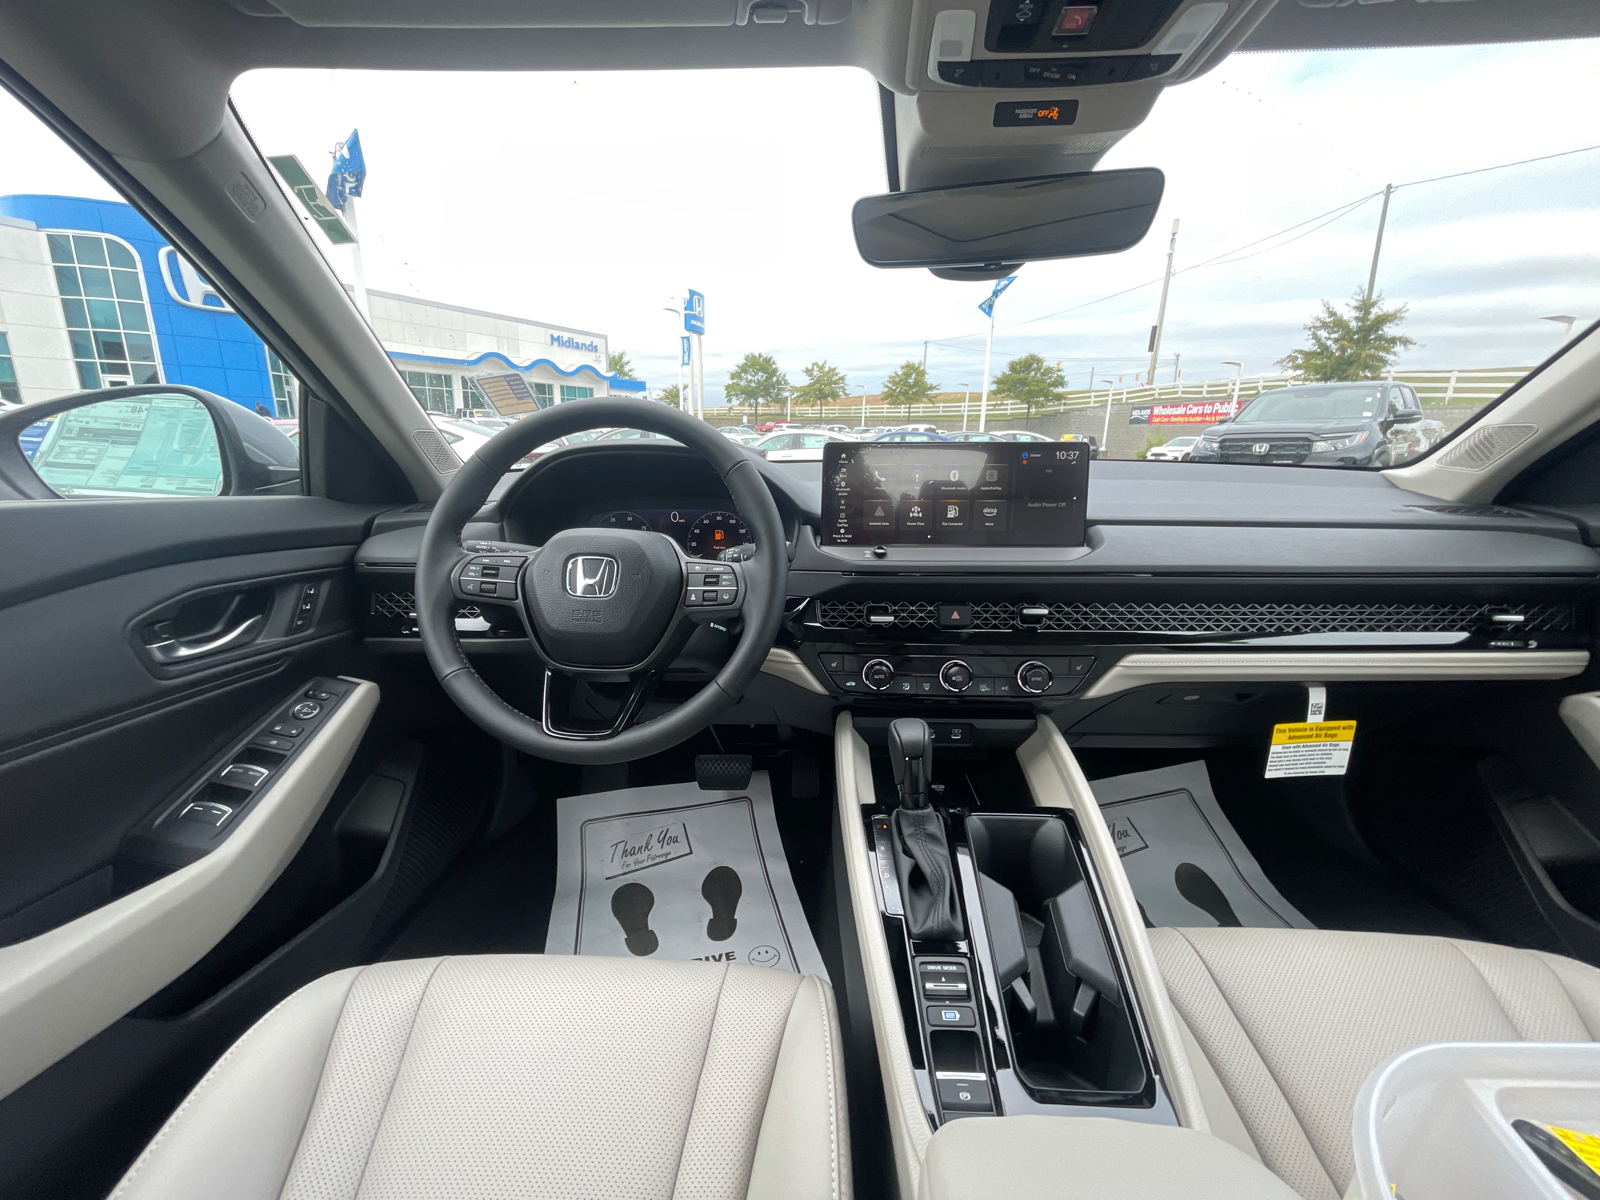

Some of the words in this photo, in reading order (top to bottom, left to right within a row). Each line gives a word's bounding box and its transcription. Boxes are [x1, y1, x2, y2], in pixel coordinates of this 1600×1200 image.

[1043, 71, 1060, 79] DOOR
[550, 333, 599, 353] Midlands
[1153, 404, 1186, 416] Wholesale
[1186, 404, 1204, 415] Cars
[1204, 404, 1213, 414] to
[1213, 401, 1239, 414] Publc
[1055, 451, 1080, 460] 10:37
[670, 511, 679, 523] 0
[1287, 733, 1314, 741] Advanced
[610, 833, 653, 863] Thank
[657, 828, 680, 849] You
[621, 861, 632, 869] For
[633, 857, 645, 866] Your
[646, 851, 672, 862] Patronage
